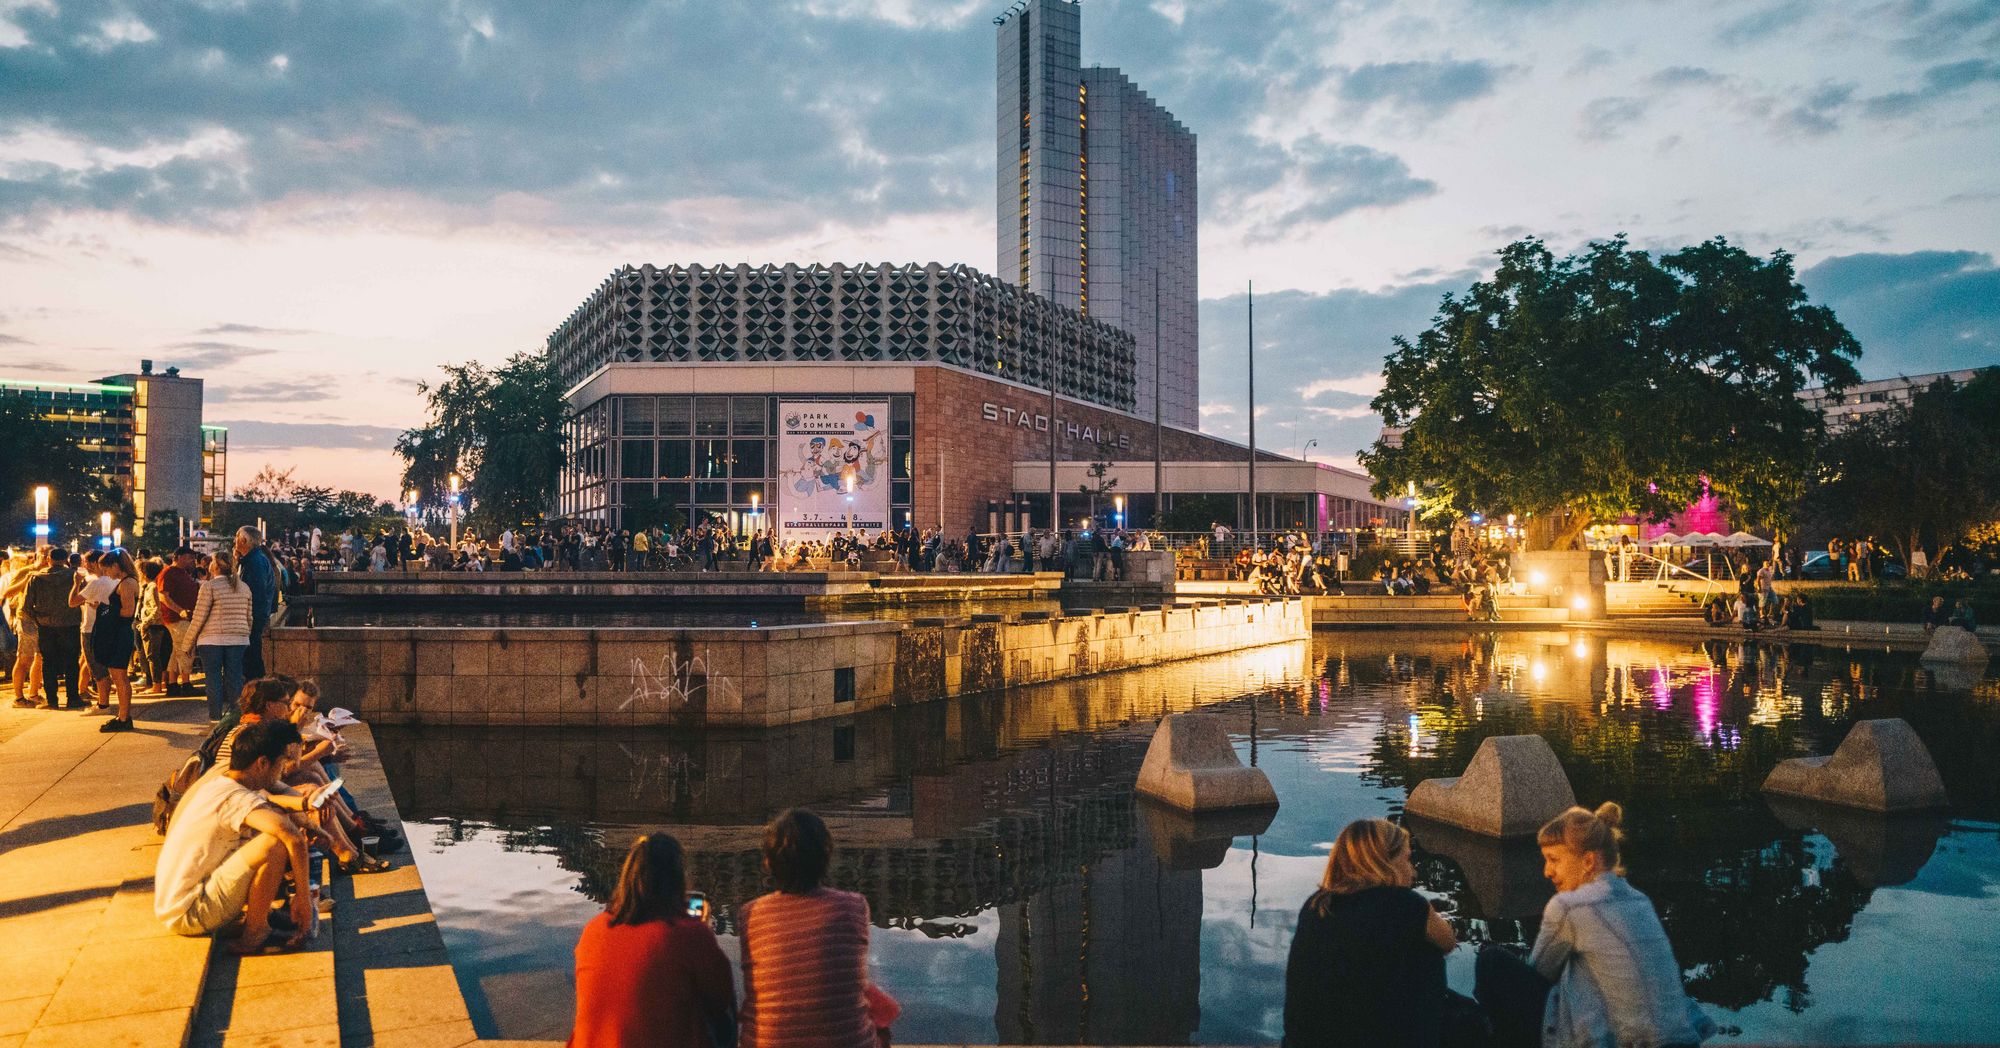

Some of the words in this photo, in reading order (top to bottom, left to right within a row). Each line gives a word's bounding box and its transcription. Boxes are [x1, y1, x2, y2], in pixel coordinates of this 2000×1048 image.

[983, 402, 1130, 449] STADTHALLE
[803, 513, 822, 521] 3.7.
[841, 513, 863, 521] 48.
